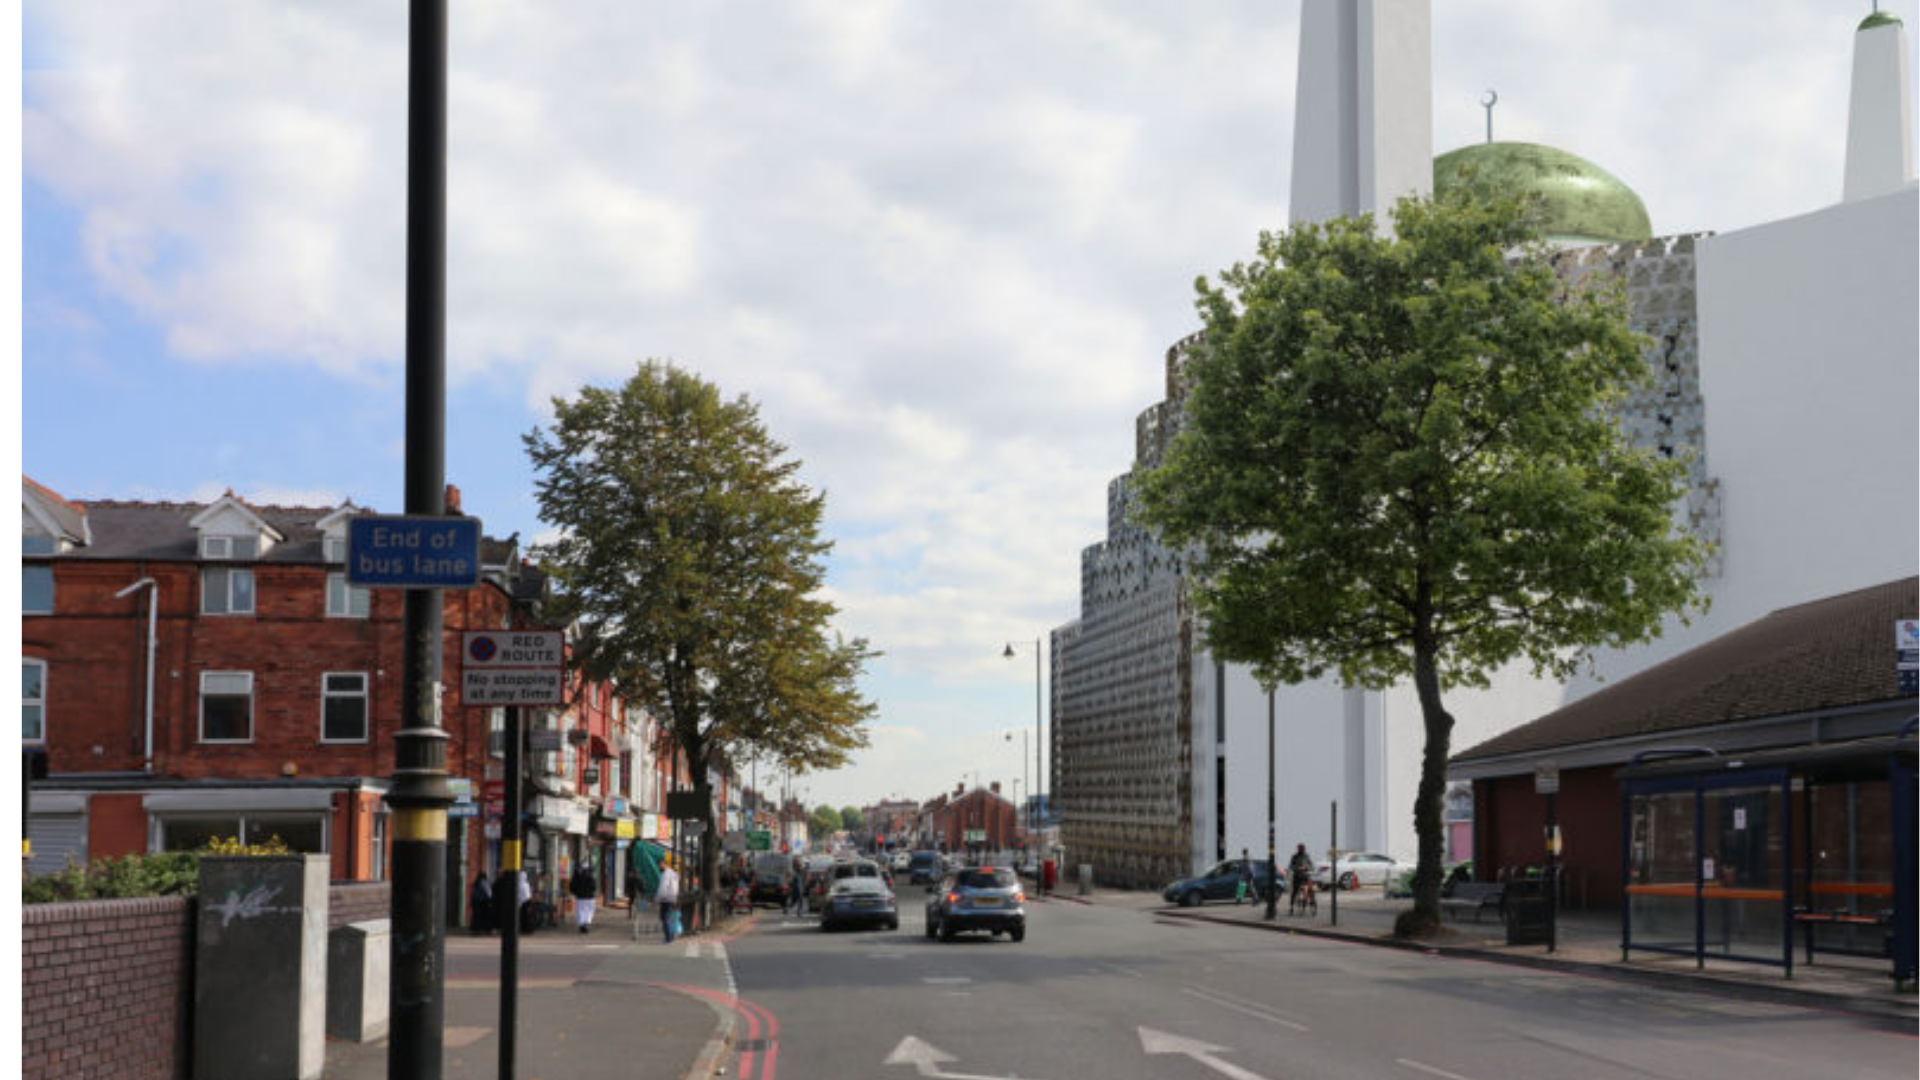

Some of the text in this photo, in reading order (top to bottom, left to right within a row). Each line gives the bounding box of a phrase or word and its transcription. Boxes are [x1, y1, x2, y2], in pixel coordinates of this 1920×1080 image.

[373, 527, 457, 549] End of
[360, 553, 467, 575] bus lane
[512, 636, 544, 647] RED
[502, 650, 554, 661] ROUTE
[467, 674, 556, 688] No stopping
[470, 688, 553, 701] at any time
